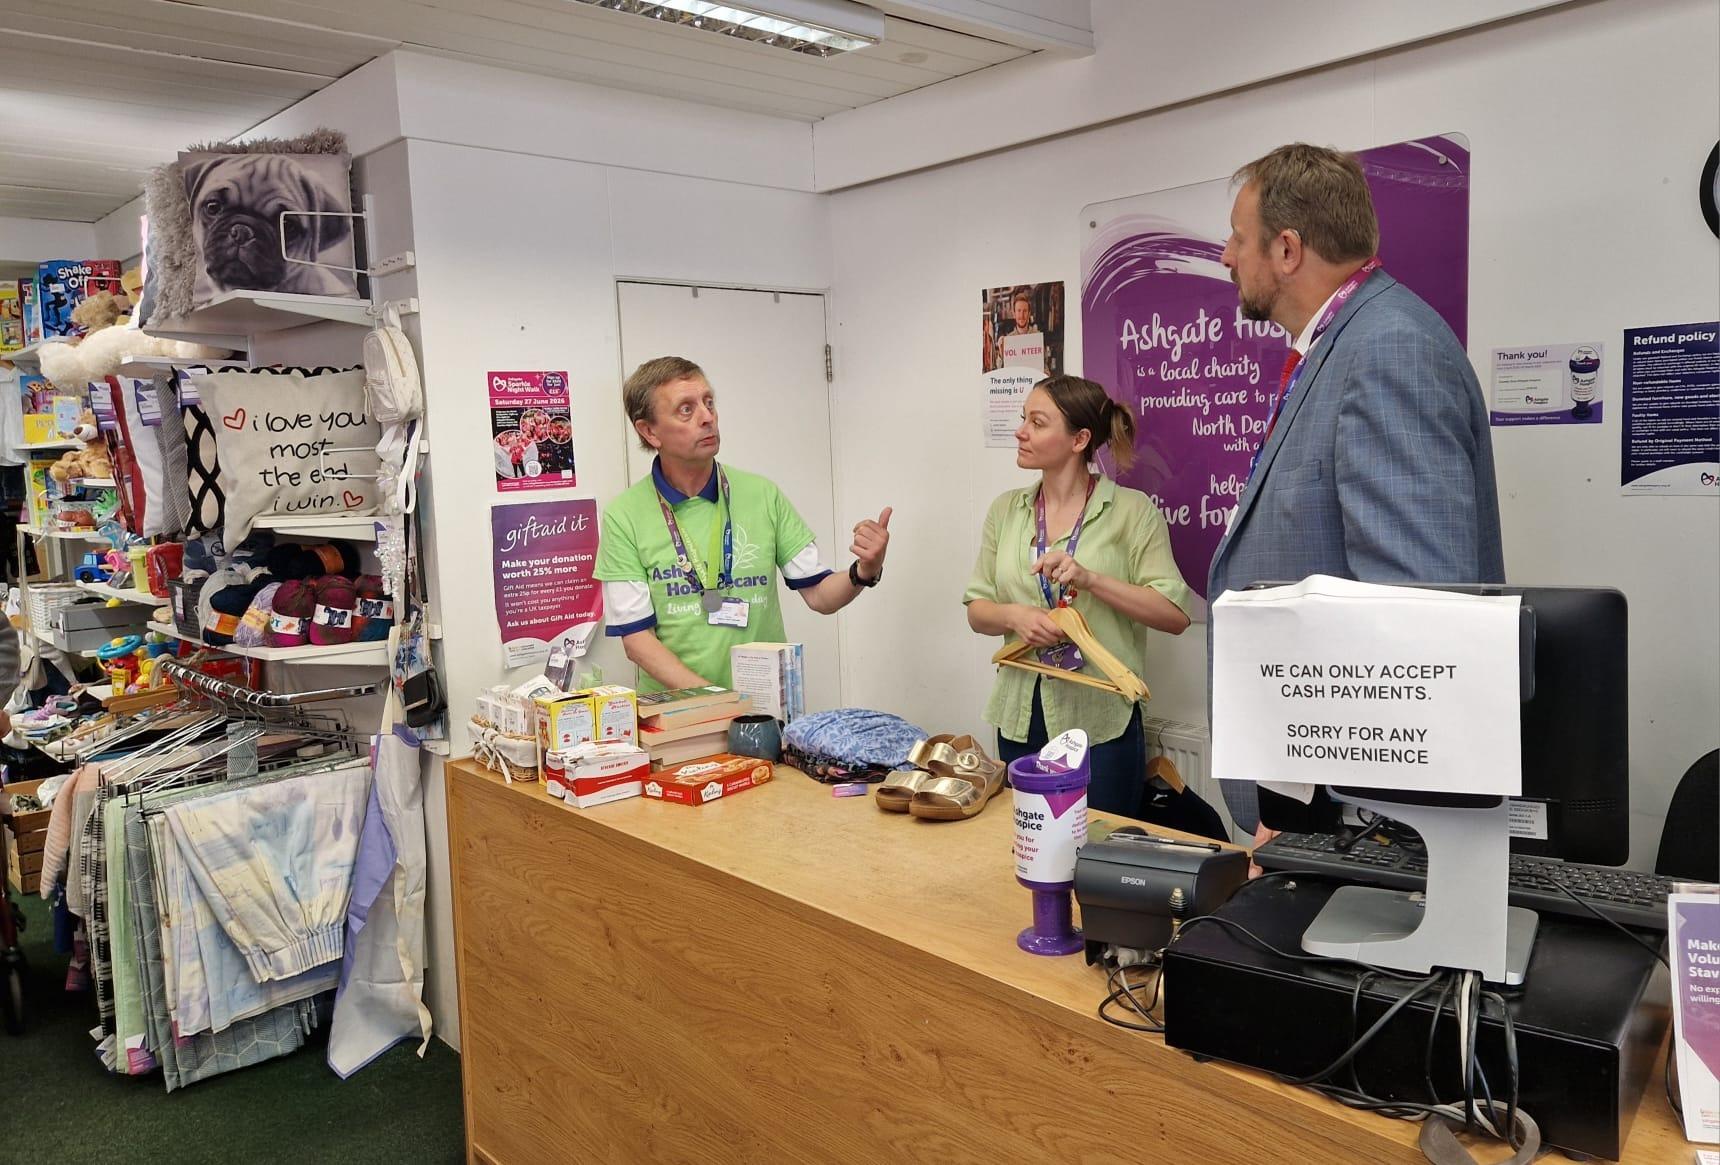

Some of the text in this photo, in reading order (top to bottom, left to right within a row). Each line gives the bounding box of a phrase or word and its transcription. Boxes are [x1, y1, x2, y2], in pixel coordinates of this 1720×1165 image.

[58, 264, 92, 280] Shake
[68, 276, 88, 289] Off
[1120, 308, 1223, 362] Ashgate
[1633, 331, 1716, 346] Refund policy
[1497, 350, 1548, 361] Thank you!
[1137, 354, 1260, 384] is a local charity
[990, 376, 1033, 386] The only thing
[990, 387, 1012, 395] missing
[1140, 387, 1211, 416] providing
[1214, 389, 1248, 406] care
[1255, 389, 1265, 403] to
[253, 412, 367, 432] i love you
[1192, 414, 1237, 436] North
[270, 438, 334, 459] most
[1224, 437, 1250, 452] with
[259, 466, 301, 486] the
[274, 495, 340, 511] i win.
[500, 514, 589, 552] giftaid it
[502, 554, 593, 569] Make your donation
[502, 565, 578, 579] worth 25% more
[552, 594, 575, 602] anything
[505, 607, 523, 616] you're
[667, 602, 701, 616] Living
[506, 620, 519, 628] Ask
[530, 616, 549, 625] about
[550, 614, 563, 622] Gift
[564, 612, 575, 620] Aid
[1260, 664, 1457, 680] WE CAN ONLY ACCEPT
[1281, 684, 1432, 701] CASH PAYMENTS.
[1286, 724, 1428, 743] SORRY FOR ANY
[1286, 744, 1429, 765] INCONVENIENCE
[1014, 817, 1043, 831] ospice
[1025, 835, 1035, 843] for
[1024, 845, 1040, 853] your
[1121, 876, 1146, 887] EPSON
[1689, 984, 1704, 993] No
